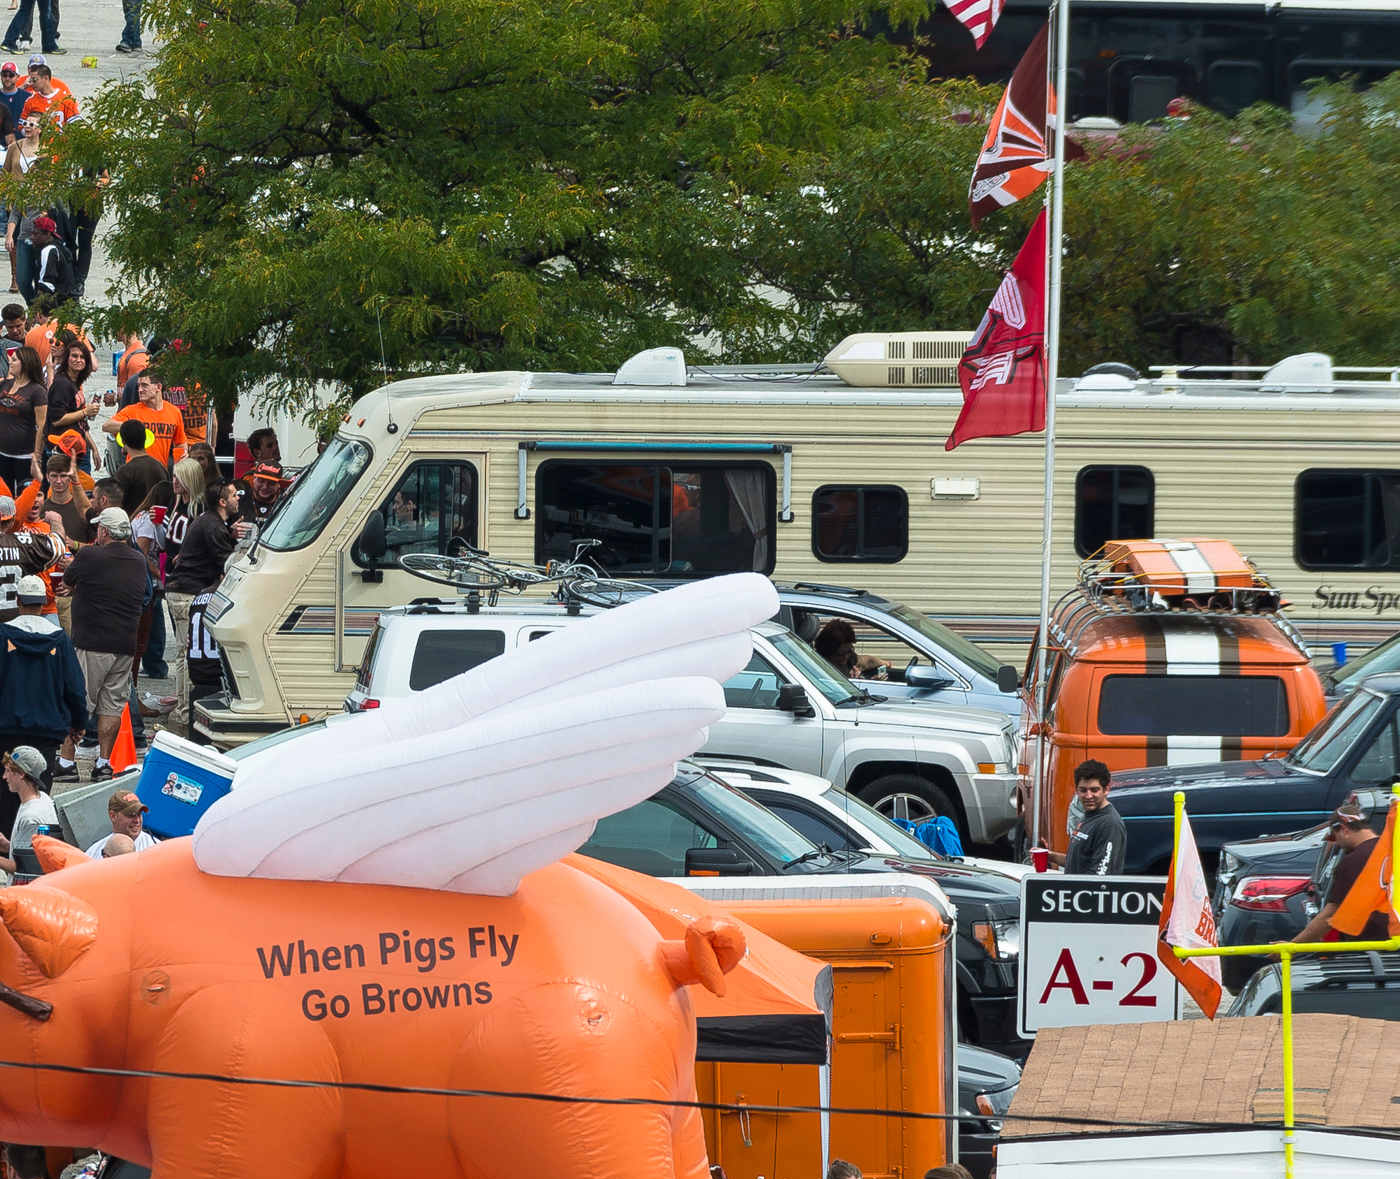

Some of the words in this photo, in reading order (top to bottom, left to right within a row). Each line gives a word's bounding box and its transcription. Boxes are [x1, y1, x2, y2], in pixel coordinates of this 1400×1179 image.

[1312, 585, 1358, 610] Sun
[1040, 889, 1164, 920] SECTION
[256, 938, 366, 979] When
[379, 929, 456, 973] Pigs
[466, 924, 520, 967] Fly
[1038, 947, 1157, 1007] A-2
[301, 988, 351, 1021] Go
[361, 979, 494, 1016] Browns
